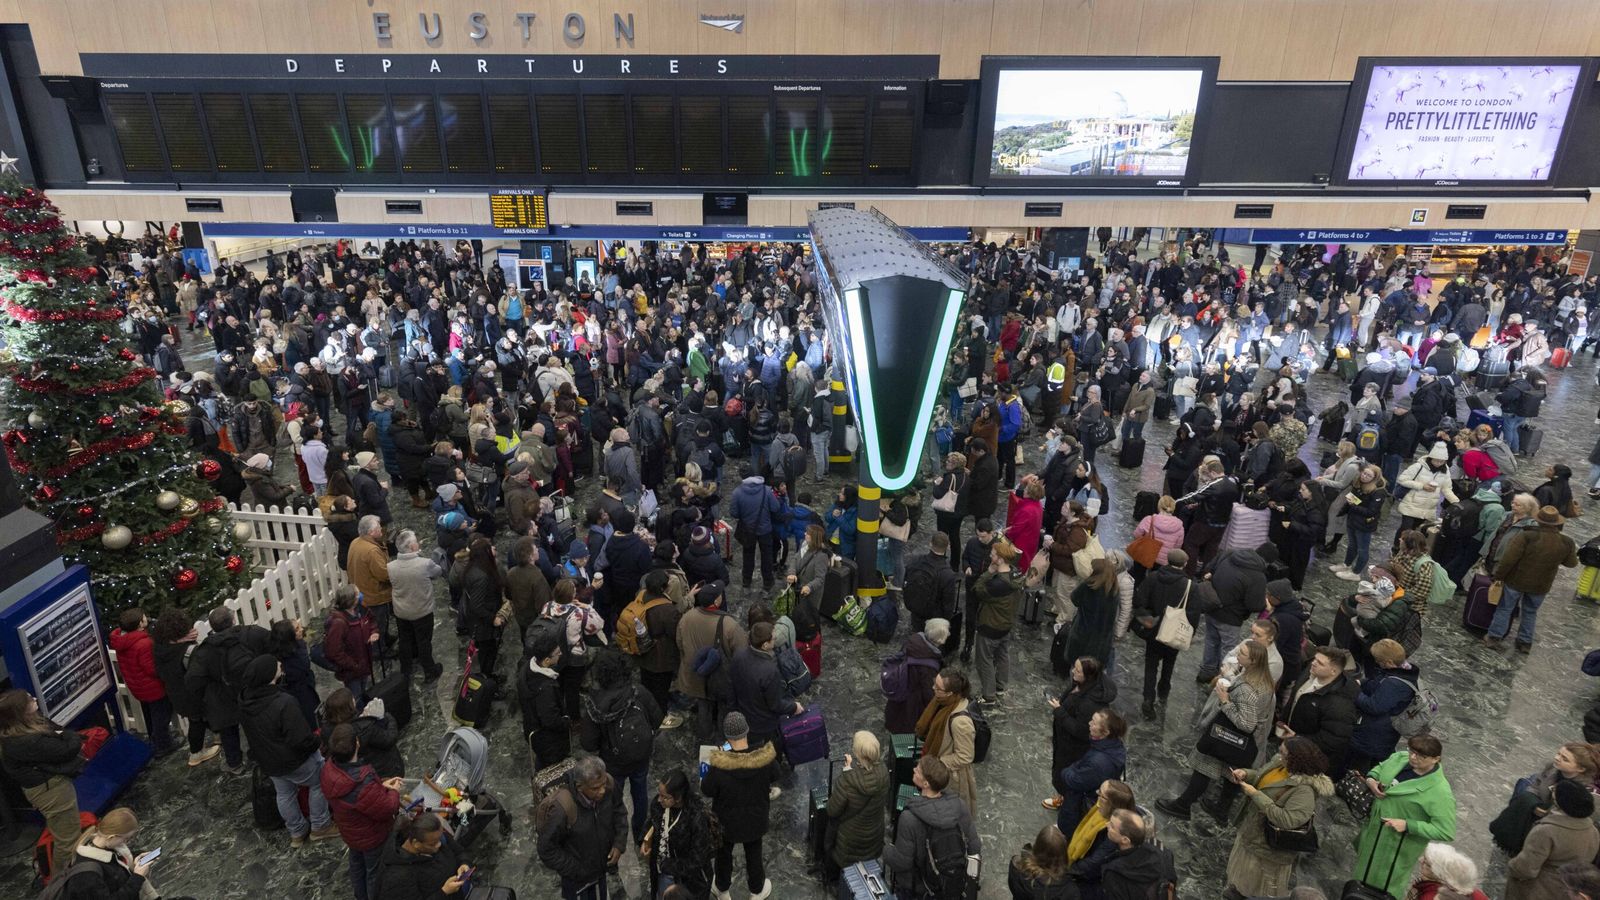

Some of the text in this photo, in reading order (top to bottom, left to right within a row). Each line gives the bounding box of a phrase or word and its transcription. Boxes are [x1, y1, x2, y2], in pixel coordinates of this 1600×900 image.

[372, 12, 635, 41] EUSTON
[286, 59, 727, 74] DEPARTURES
[1416, 98, 1513, 106] WELCOME TO LONDON
[1384, 111, 1539, 131] PRETTYLITTLETHING
[1418, 135, 1495, 143] FASHION BEAUTY LIFESTYLE
[1318, 231, 1350, 239] Platforms
[1356, 231, 1364, 239] to
[1364, 231, 1370, 239] 7
[1494, 232, 1525, 240] Platforms
[1530, 232, 1539, 240] to
